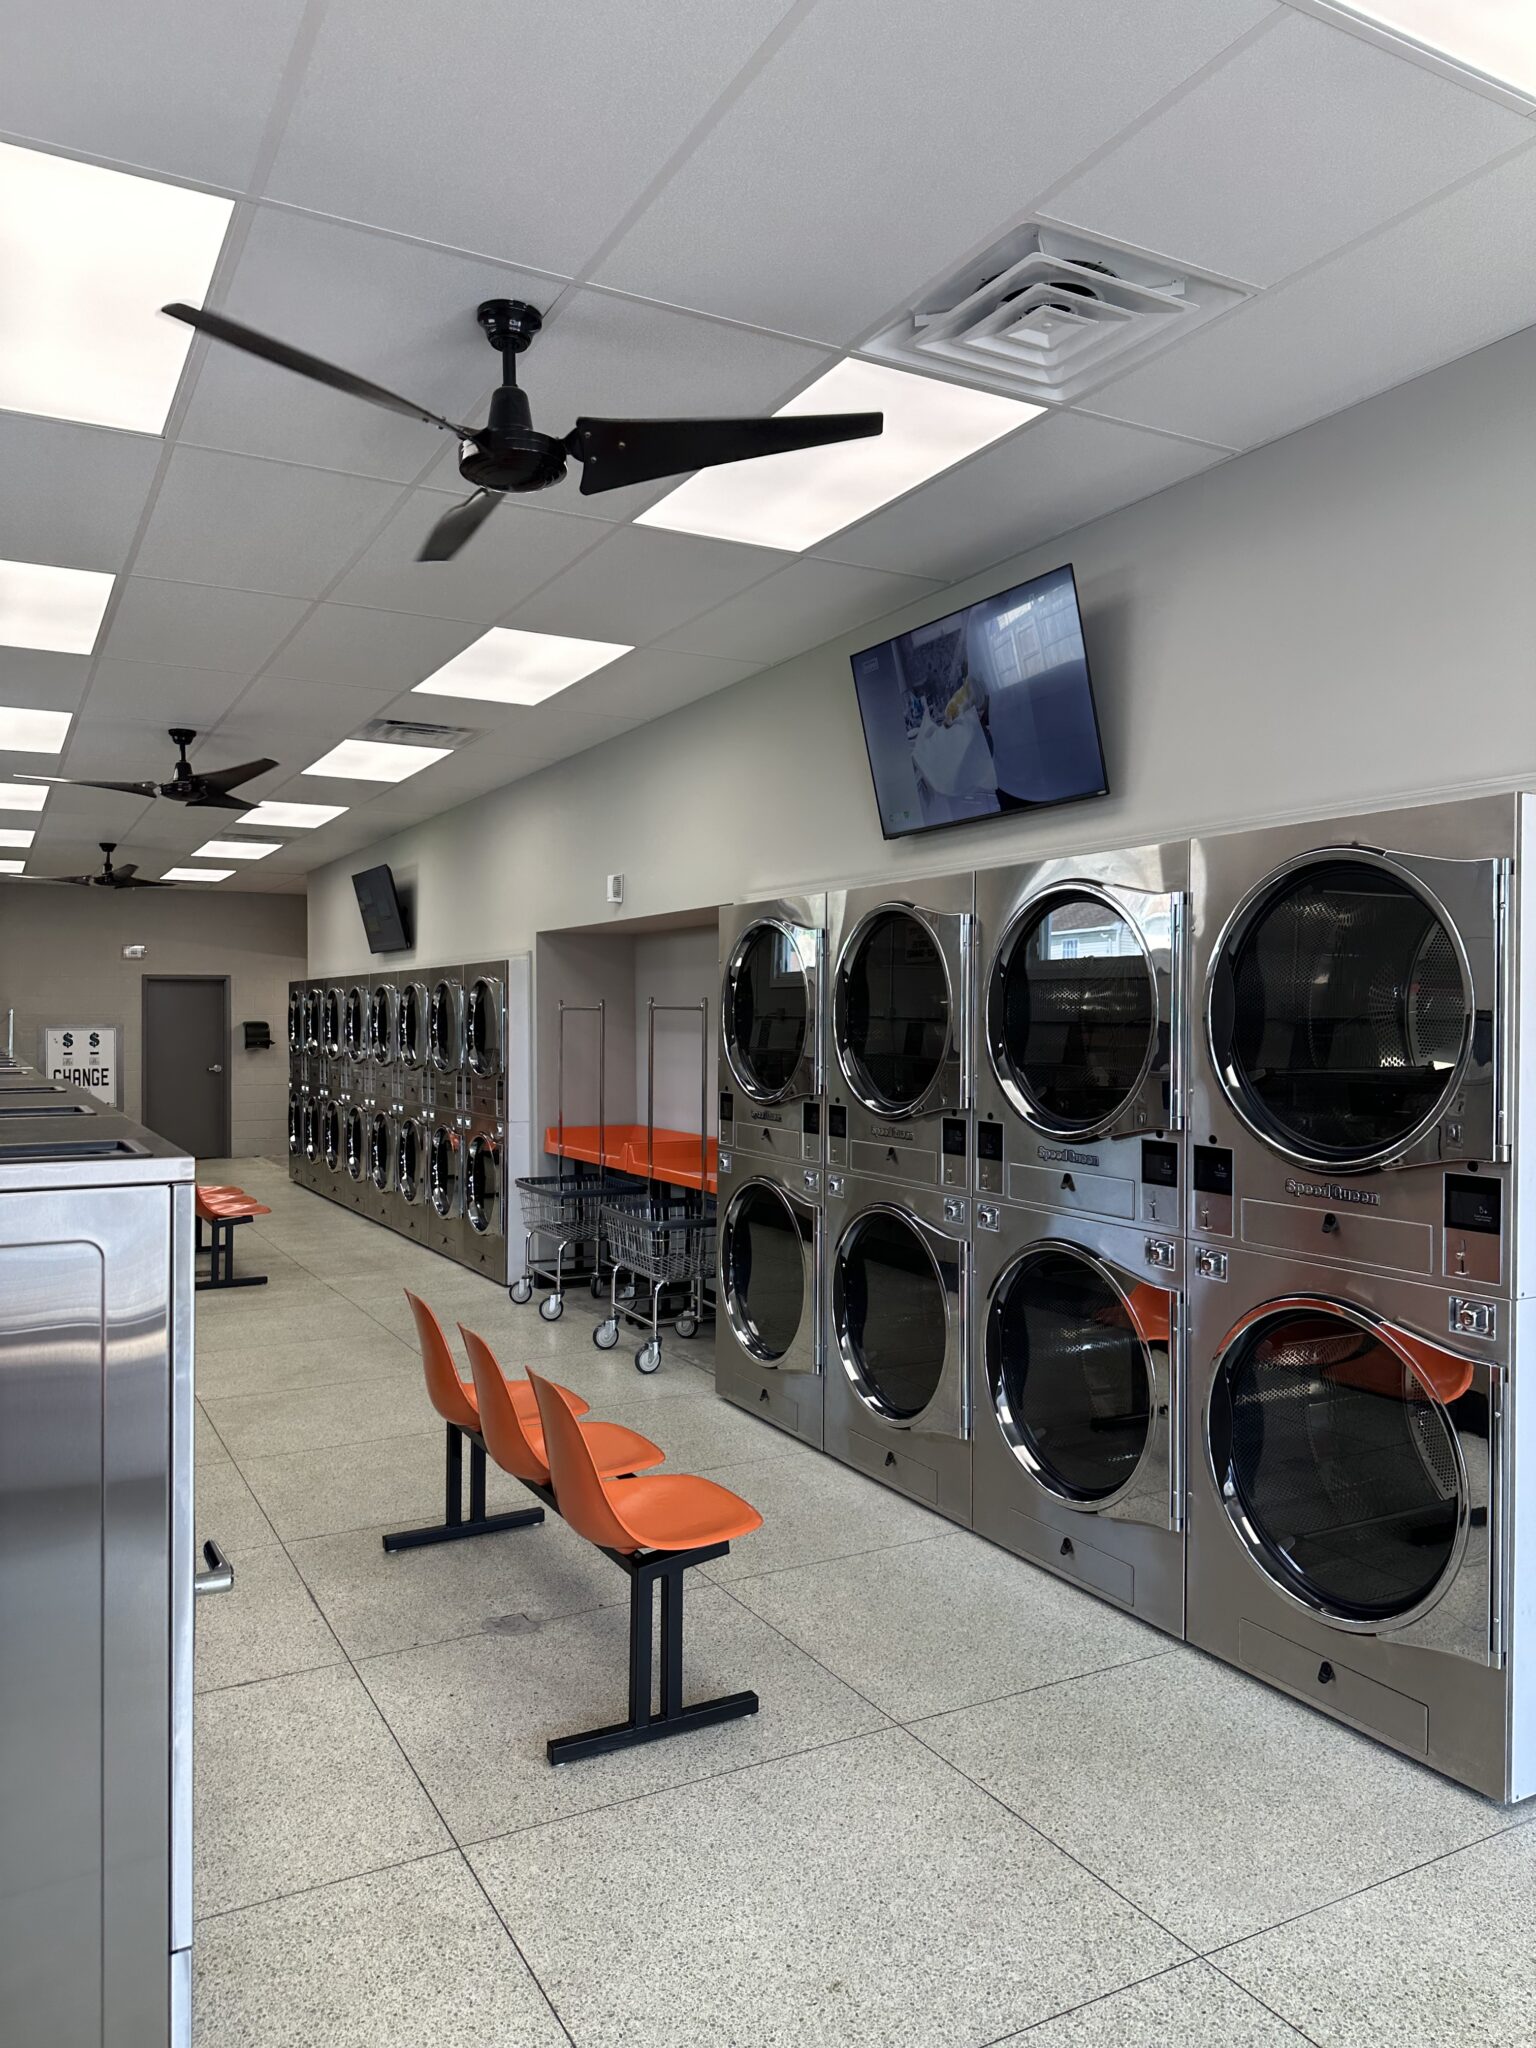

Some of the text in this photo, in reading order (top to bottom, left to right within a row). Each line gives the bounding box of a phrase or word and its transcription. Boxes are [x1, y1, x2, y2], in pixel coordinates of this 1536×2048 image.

[62, 1032, 100, 1048] $ $
[53, 1068, 109, 1086] CHANGE
[1285, 1178, 1380, 1206] Speed Queen
